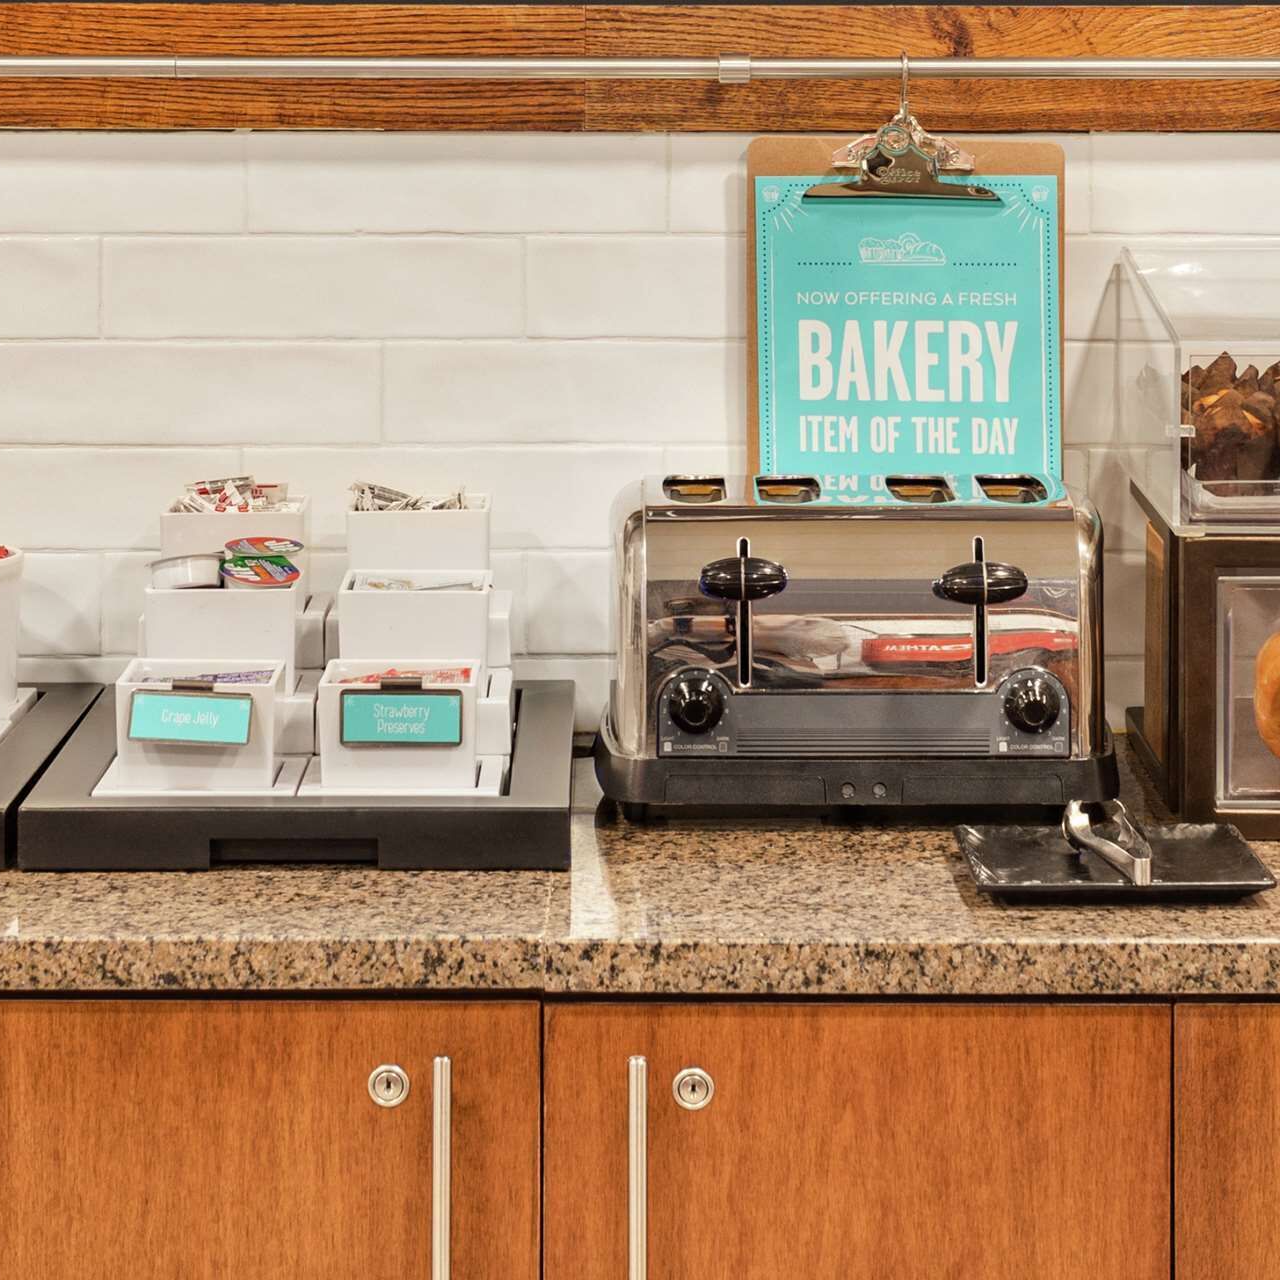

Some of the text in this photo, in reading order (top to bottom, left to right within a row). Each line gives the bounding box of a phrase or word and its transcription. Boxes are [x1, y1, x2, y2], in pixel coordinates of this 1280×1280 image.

[796, 291, 1017, 306] NOW OFFERING A FRESH
[798, 319, 1018, 402] BAKERY
[799, 415, 1019, 456] ITEM OF THE DAY
[161, 709, 220, 729] Grape Jelly
[373, 703, 431, 721] Strawberry
[377, 720, 427, 734] Preserves
